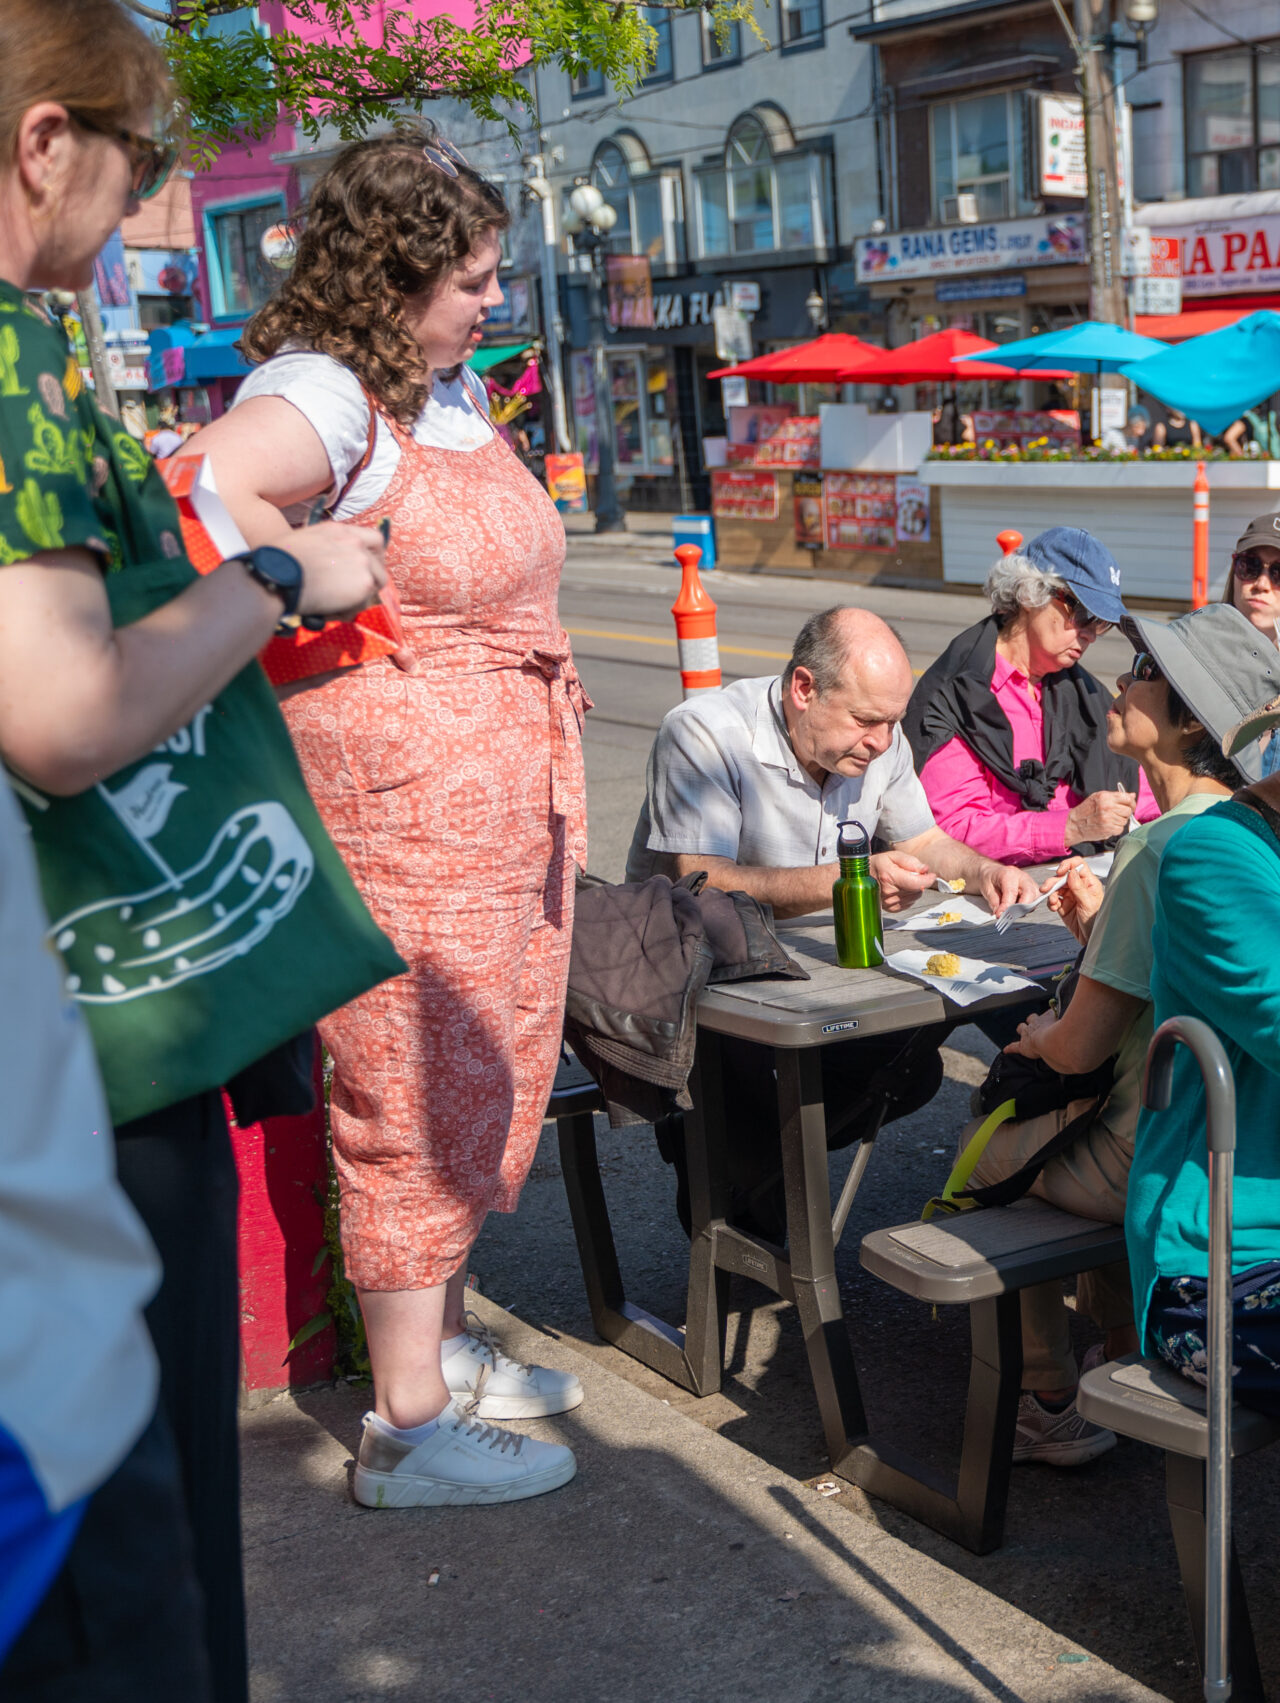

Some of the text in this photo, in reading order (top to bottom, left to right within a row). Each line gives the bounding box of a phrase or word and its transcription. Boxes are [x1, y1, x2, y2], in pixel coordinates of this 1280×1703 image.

[900, 232, 945, 260] RANA
[948, 226, 998, 255] GEMS
[826, 1021, 854, 1032] LIFETIME
